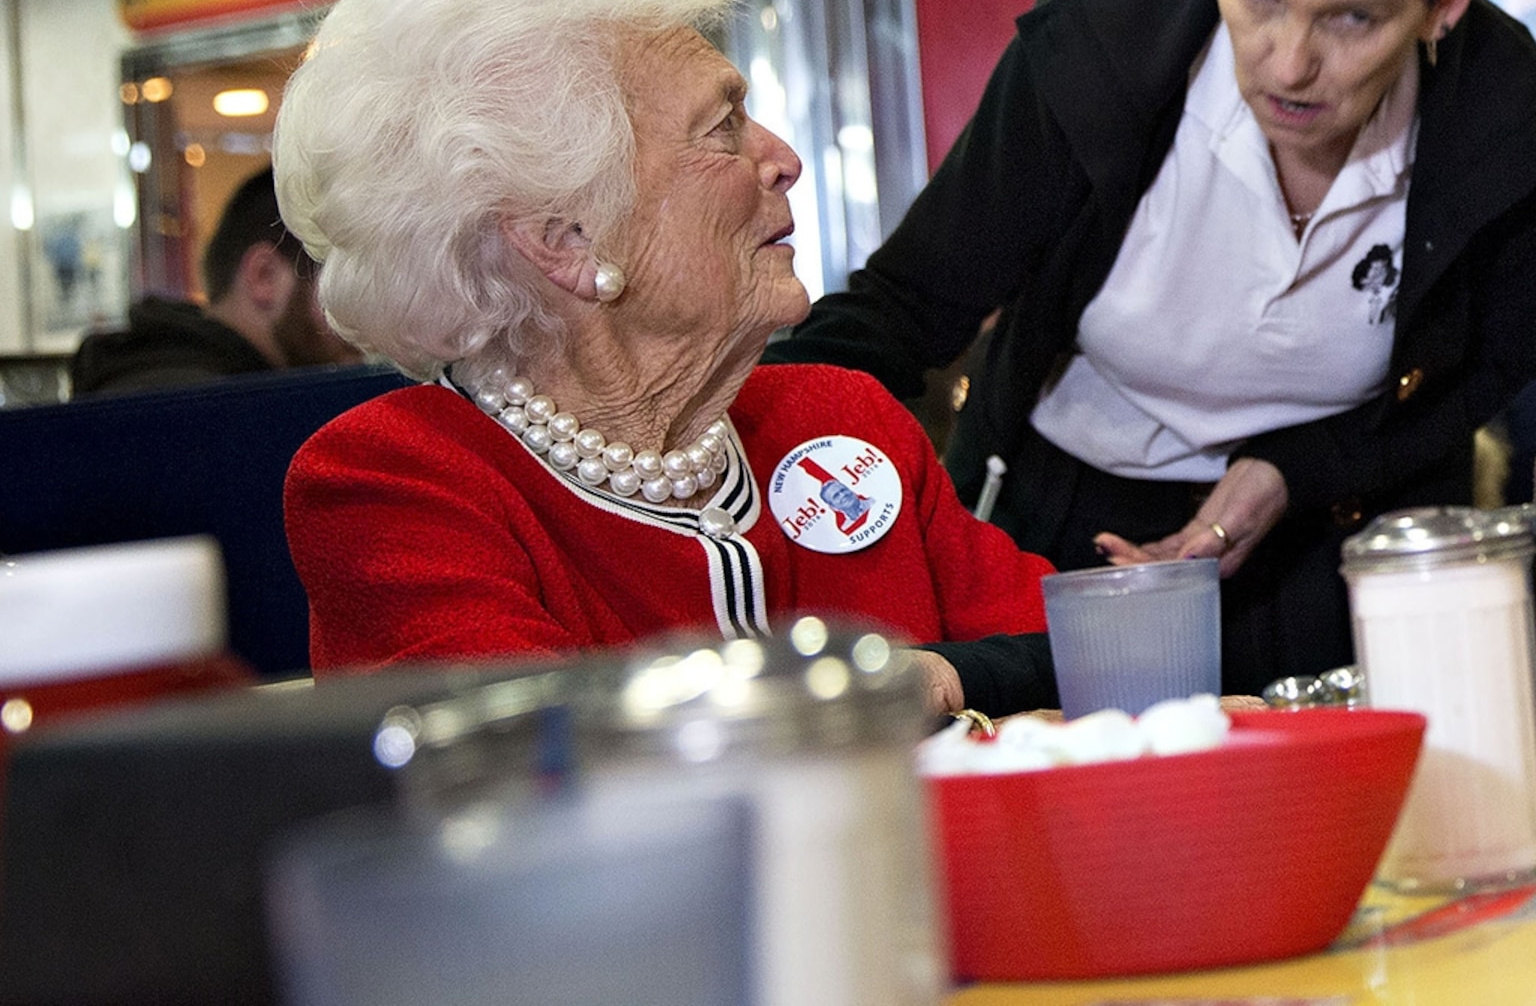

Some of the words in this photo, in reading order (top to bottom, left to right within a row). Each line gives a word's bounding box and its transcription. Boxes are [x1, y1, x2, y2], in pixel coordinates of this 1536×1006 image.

[774, 472, 787, 493] NEW
[783, 440, 832, 473] HAMPSHIRE
[841, 447, 884, 485] Jeb!
[782, 497, 826, 539] Jeb!
[849, 502, 894, 545] SUPPORTS
